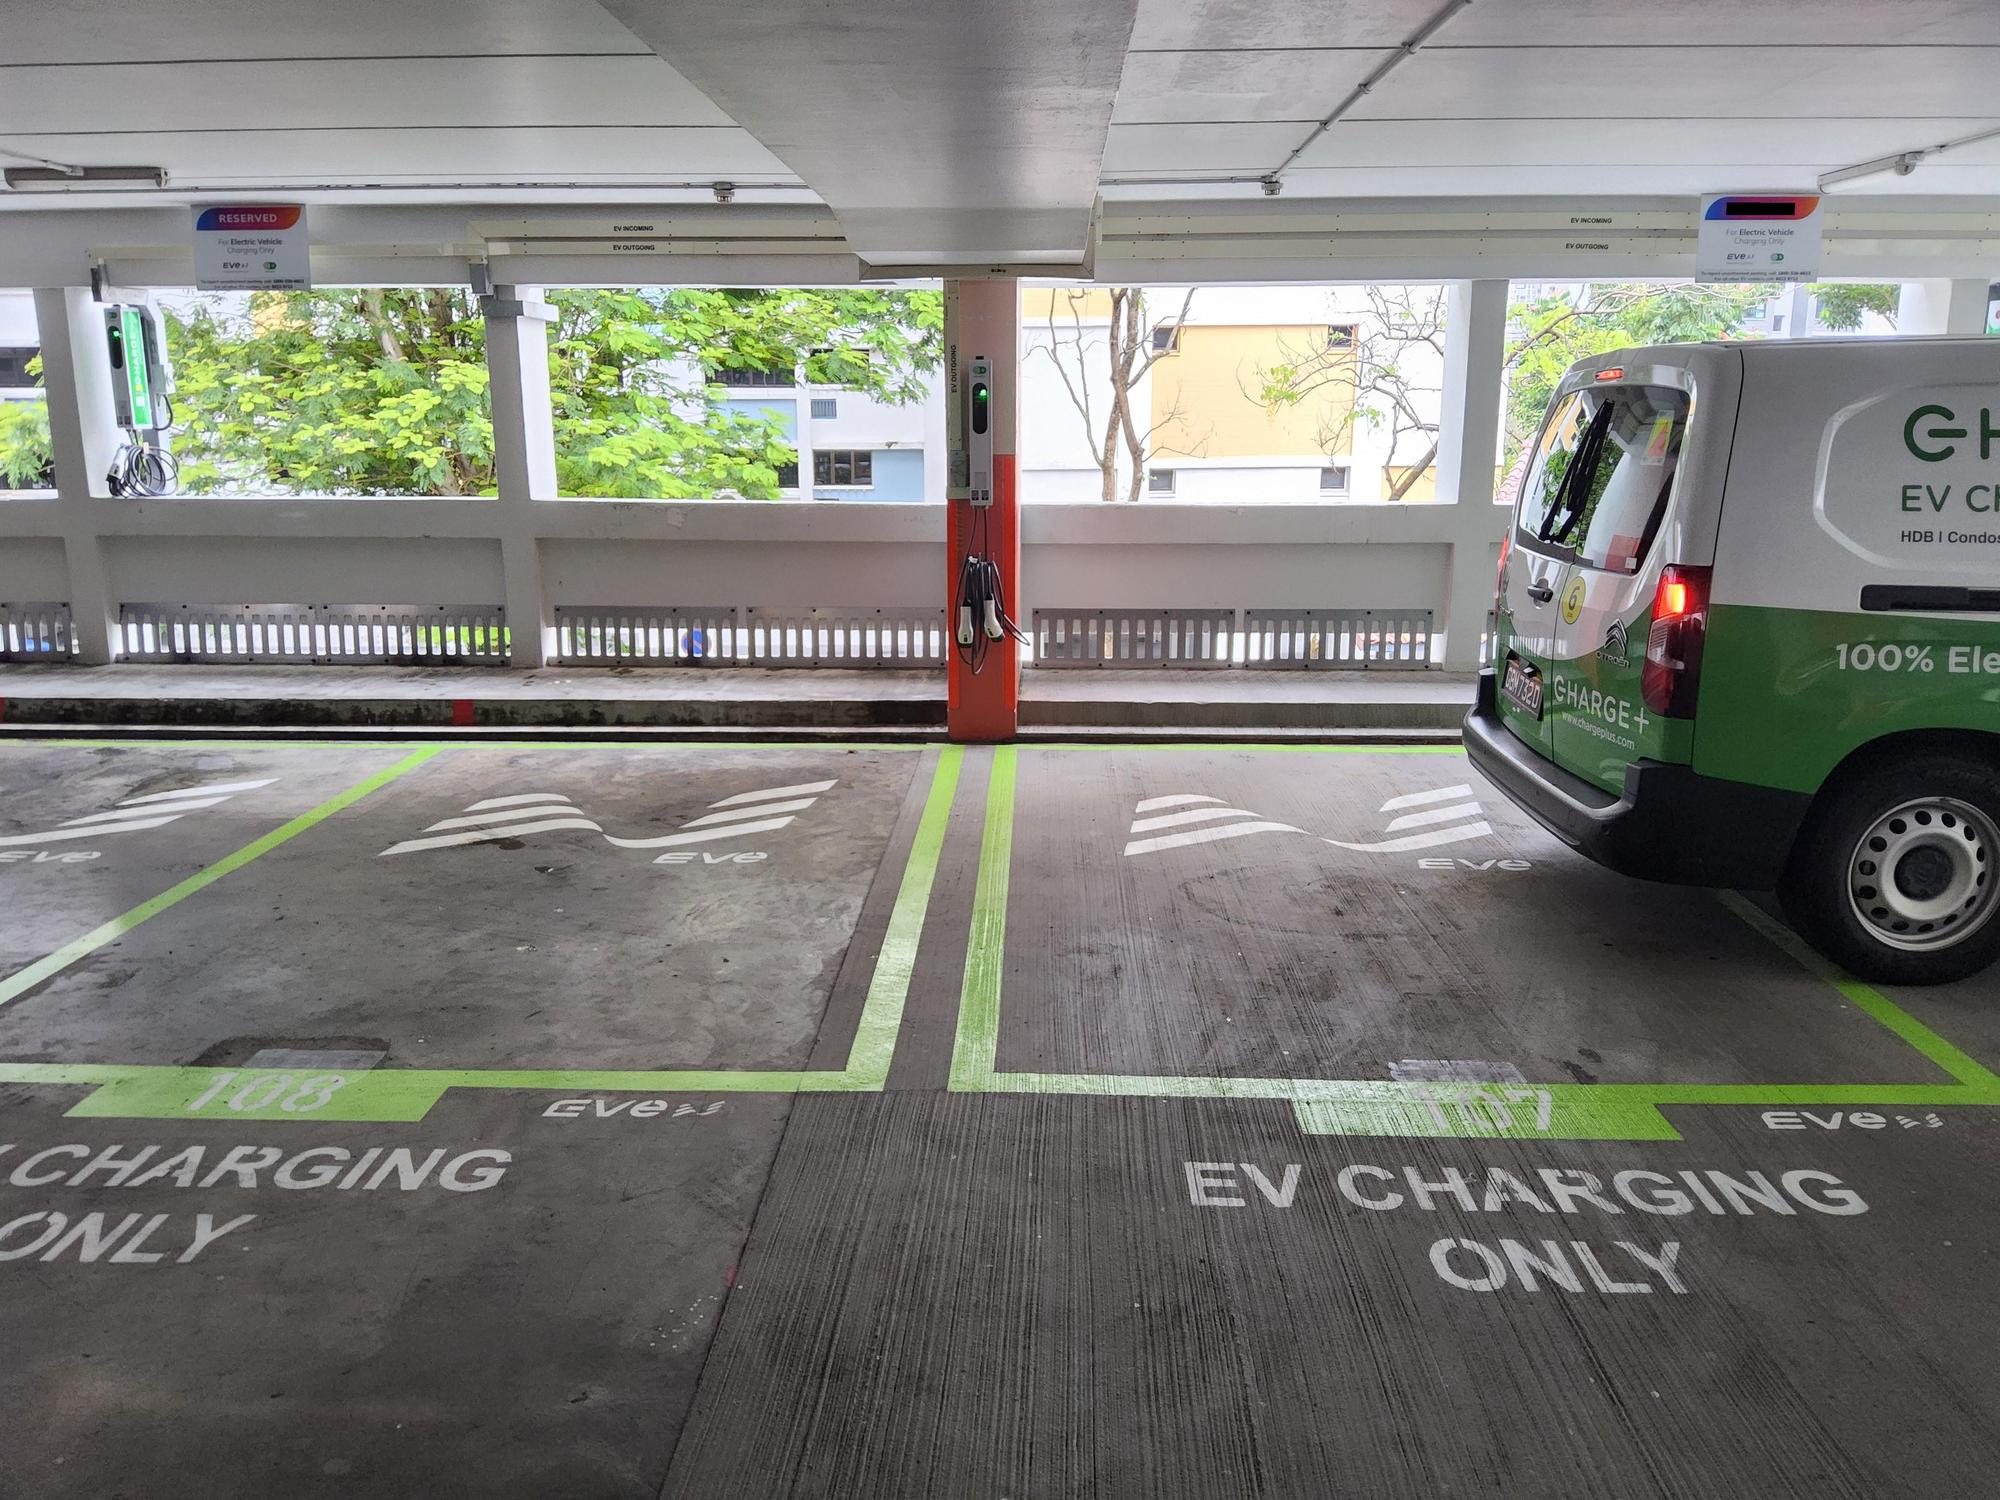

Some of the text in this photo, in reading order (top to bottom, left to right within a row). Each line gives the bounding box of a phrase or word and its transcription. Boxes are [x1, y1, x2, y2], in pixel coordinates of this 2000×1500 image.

[218, 214, 277, 223] RESERVED
[1726, 228, 1795, 236] For Electric Vehicle
[218, 238, 283, 246] For Electric Vehicle
[227, 247, 276, 255] Charging Only
[1734, 238, 1785, 247] Charging Only
[950, 344, 958, 393] EV OUTGOING
[1901, 484, 2000, 513] EV C
[1901, 530, 1934, 543] HDB
[1569, 586, 1581, 611] 6
[1836, 643, 1935, 673] 100%
[1562, 711, 1635, 750] www.chargeplus.com
[187, 1072, 346, 1112] 108
[1409, 1086, 1553, 1131] 107
[9, 1144, 513, 1192] CHARGING
[1184, 1161, 1871, 1216] EV CHARGING
[0, 1212, 258, 1264] ONLY
[1429, 1238, 1689, 1295] ONLY
